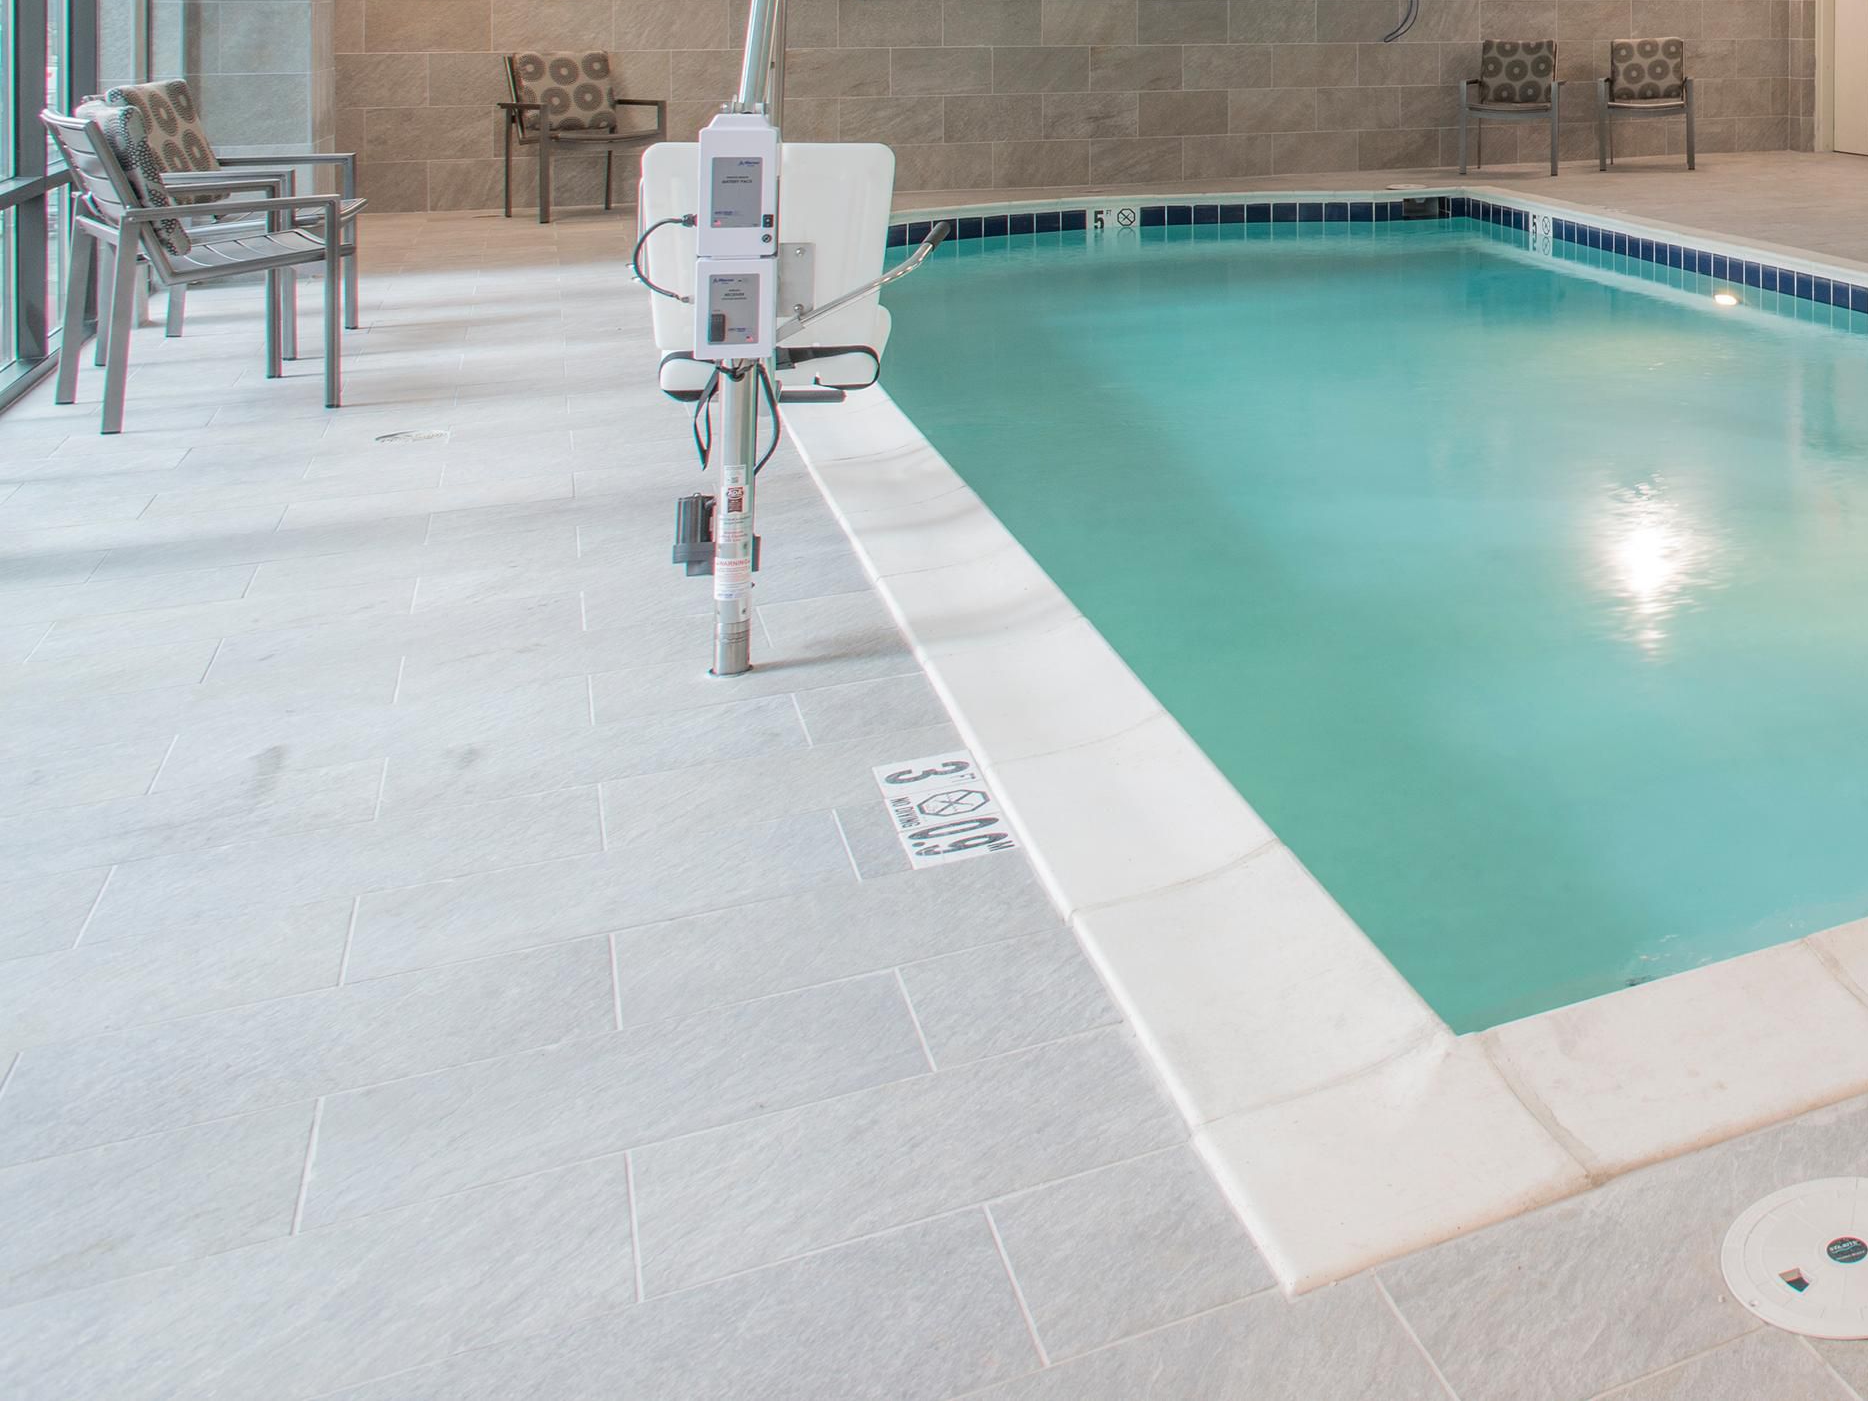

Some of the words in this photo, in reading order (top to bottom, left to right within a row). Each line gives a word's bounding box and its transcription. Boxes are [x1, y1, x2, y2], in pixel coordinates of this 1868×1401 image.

[1094, 210, 1104, 230] 5
[884, 760, 970, 785] 3
[890, 796, 911, 808] NO
[895, 807, 921, 829] DIVING
[907, 816, 1009, 857] 0.9
